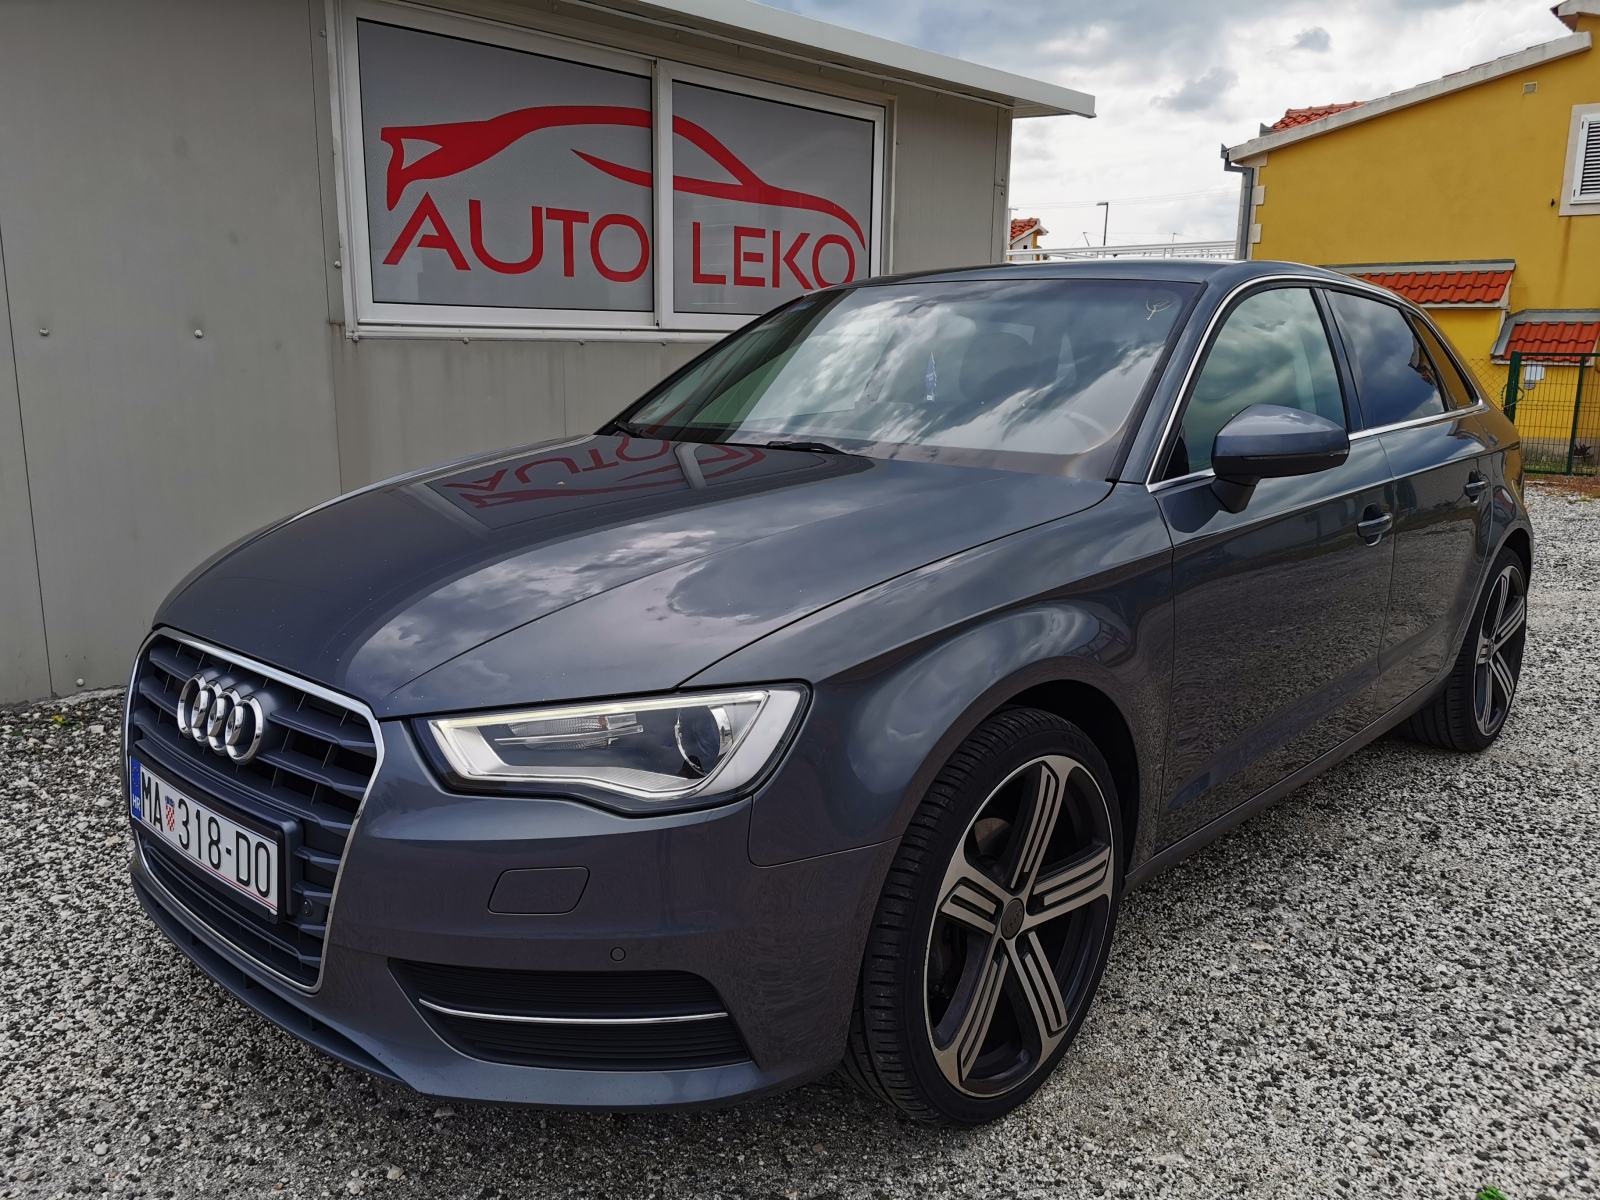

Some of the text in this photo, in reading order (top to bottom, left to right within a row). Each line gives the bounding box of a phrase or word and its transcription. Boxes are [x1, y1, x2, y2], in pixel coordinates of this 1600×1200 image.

[382, 191, 856, 290] AUTO LEKO
[132, 794, 141, 812] HR
[141, 771, 271, 898] MA 318-DO
